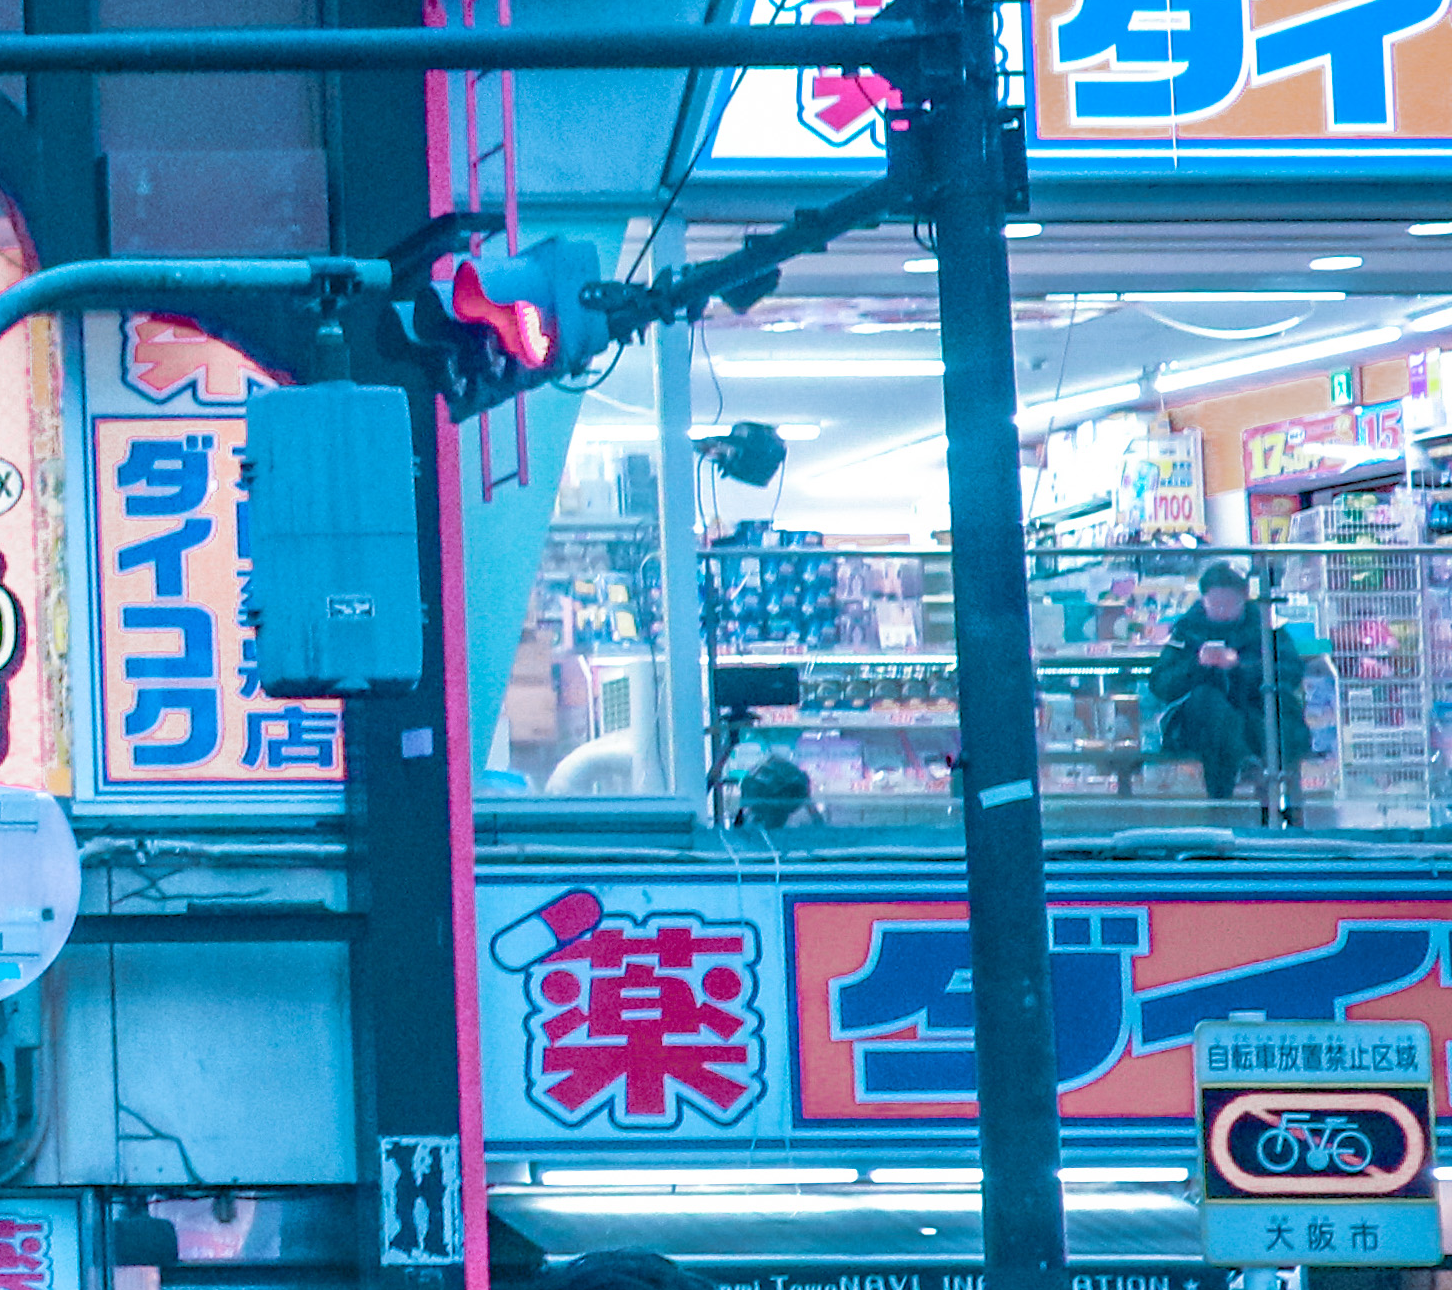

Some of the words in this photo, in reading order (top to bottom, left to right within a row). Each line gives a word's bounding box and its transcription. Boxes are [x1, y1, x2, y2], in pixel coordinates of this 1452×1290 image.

[115, 433, 226, 771] ダイコク
[542, 924, 749, 1115] 薬
[1208, 1043, 1419, 1073] 自転車放置禁止区域
[1266, 1221, 1380, 1253] 大阪市
